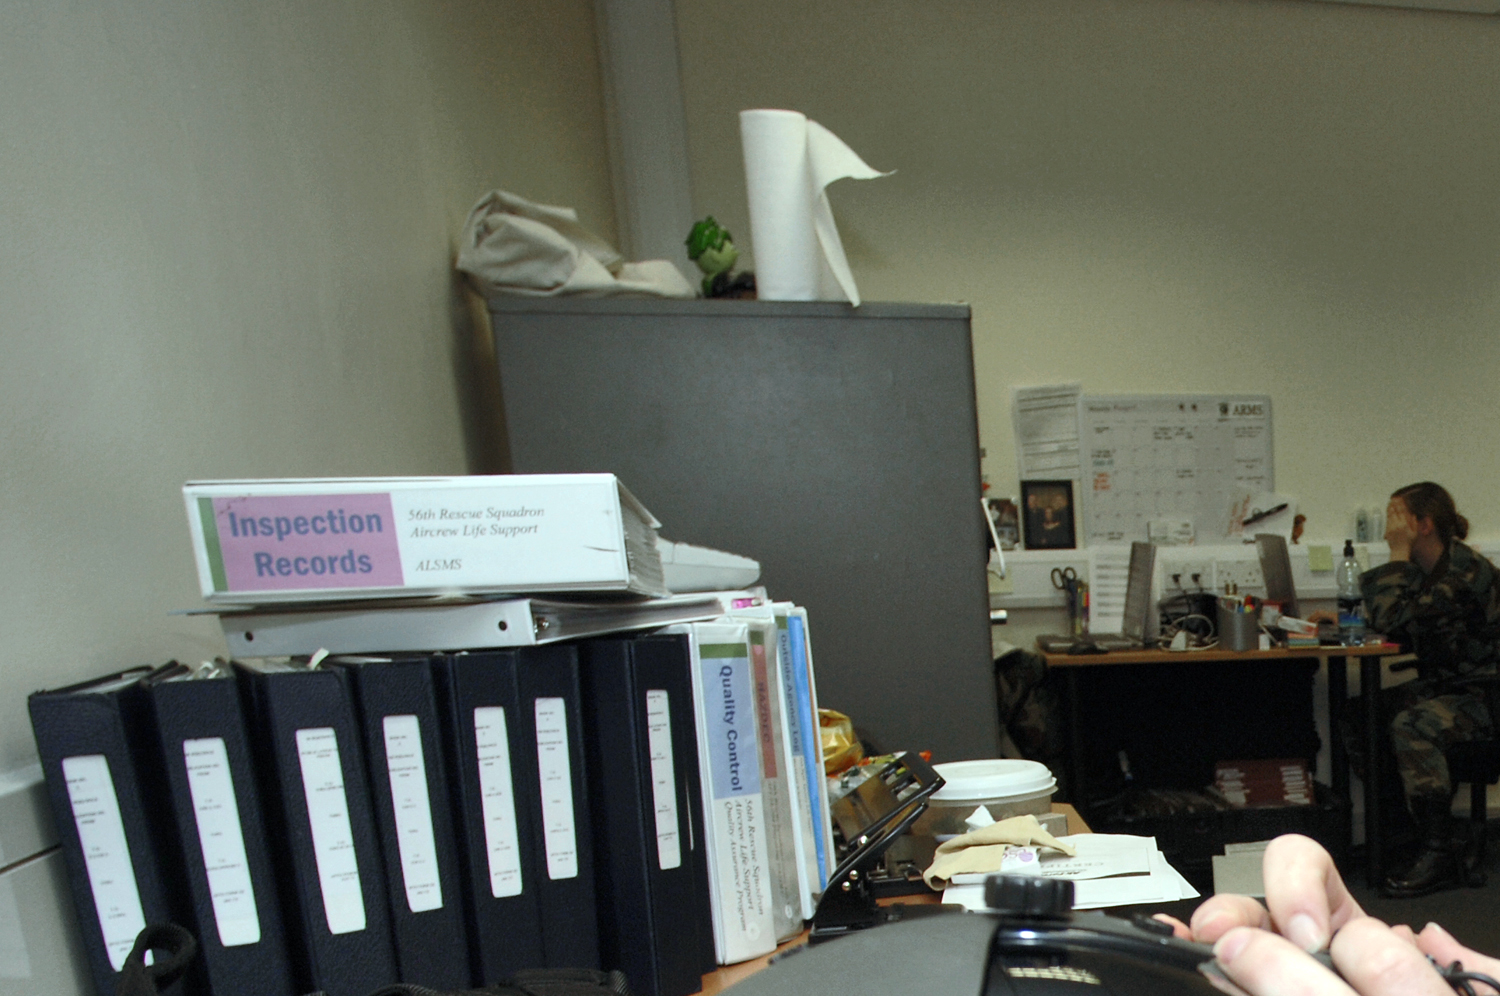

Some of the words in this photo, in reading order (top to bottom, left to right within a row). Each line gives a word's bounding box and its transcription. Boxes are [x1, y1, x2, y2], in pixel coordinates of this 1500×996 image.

[228, 508, 383, 542] Inspection
[408, 508, 436, 521] 56th
[439, 508, 483, 520] Rescue
[485, 506, 545, 522] Squadron
[410, 526, 459, 538] Aircrew
[462, 524, 487, 538] Life
[489, 524, 539, 539] Support
[253, 549, 373, 577] Records
[415, 558, 462, 572] ALSMS
[719, 665, 737, 725] Quality
[780, 634, 791, 683] Outside
[786, 684, 796, 726] Agency
[727, 729, 743, 791] Control
[735, 800, 744, 842] Aircrew
[744, 798, 753, 823] 56th
[740, 845, 749, 864] Life
[748, 825, 756, 861] Rescue
[725, 801, 734, 835] Quality
[730, 838, 741, 888] Assurance
[736, 890, 747, 932] Program
[743, 866, 754, 910] Support
[752, 864, 764, 916] Squadron
